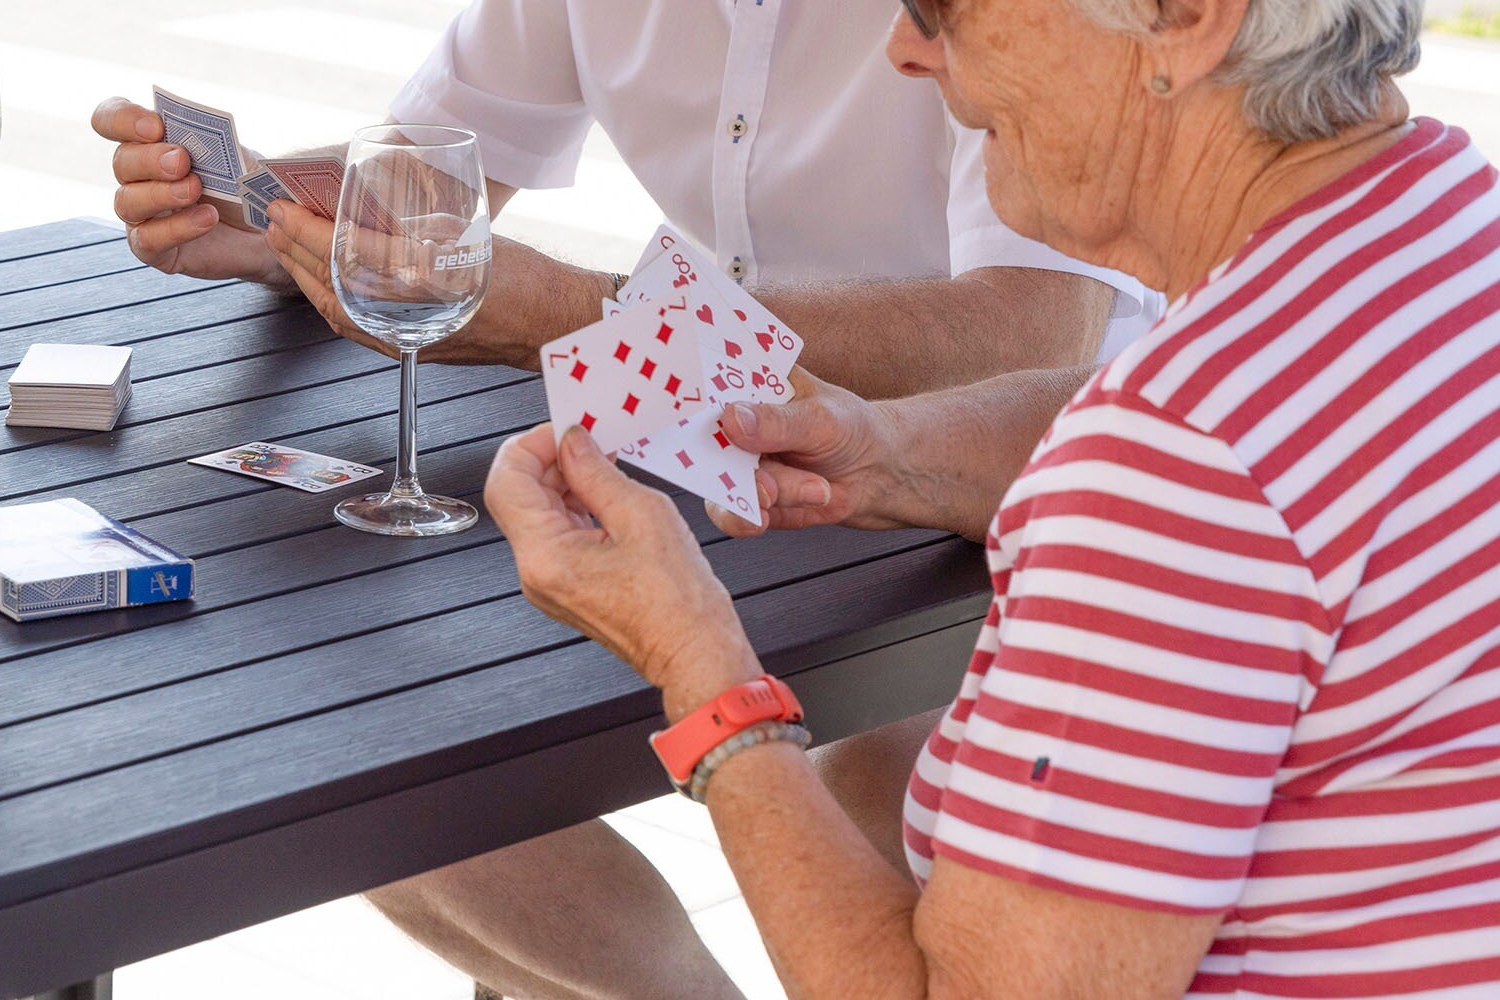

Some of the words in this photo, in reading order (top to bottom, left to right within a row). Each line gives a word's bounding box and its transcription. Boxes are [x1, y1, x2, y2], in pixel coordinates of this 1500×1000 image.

[672, 253, 691, 274] 8
[726, 364, 745, 389] 10
[766, 373, 785, 396] 8
